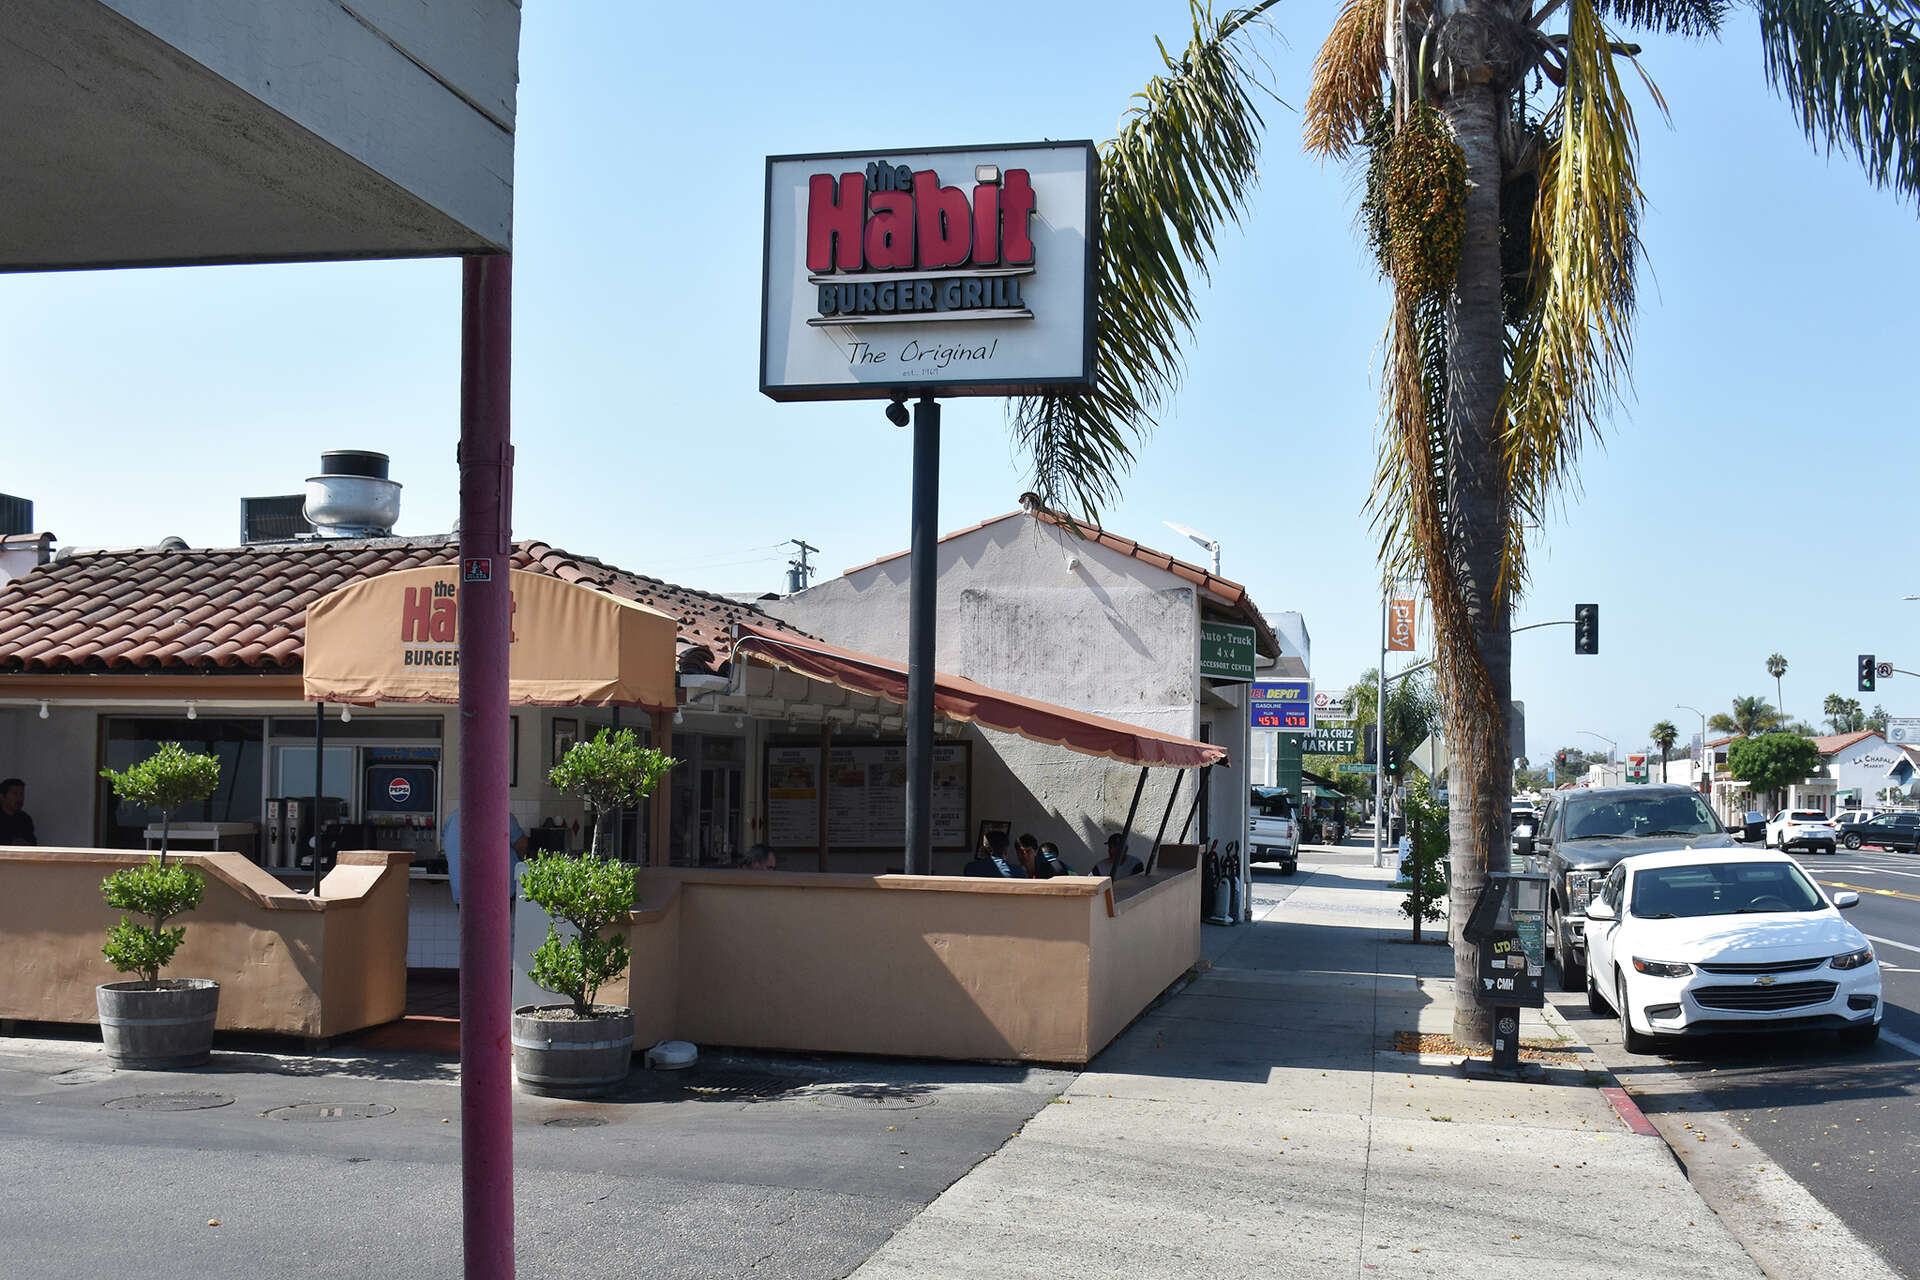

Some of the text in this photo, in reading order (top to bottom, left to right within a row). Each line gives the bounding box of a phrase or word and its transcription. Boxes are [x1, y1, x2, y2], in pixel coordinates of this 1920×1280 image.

[866, 160, 912, 192] the
[806, 165, 1037, 273] Habit
[818, 276, 1026, 316] BURGER GRILL
[848, 339, 998, 368] The Original
[434, 580, 455, 597] the
[1392, 606, 1412, 647] play
[1227, 633, 1251, 646] Truck
[1266, 688, 1300, 698] DEPOT
[1304, 729, 1354, 738] ANTA CRUZ
[1494, 940, 1511, 954] LTD
